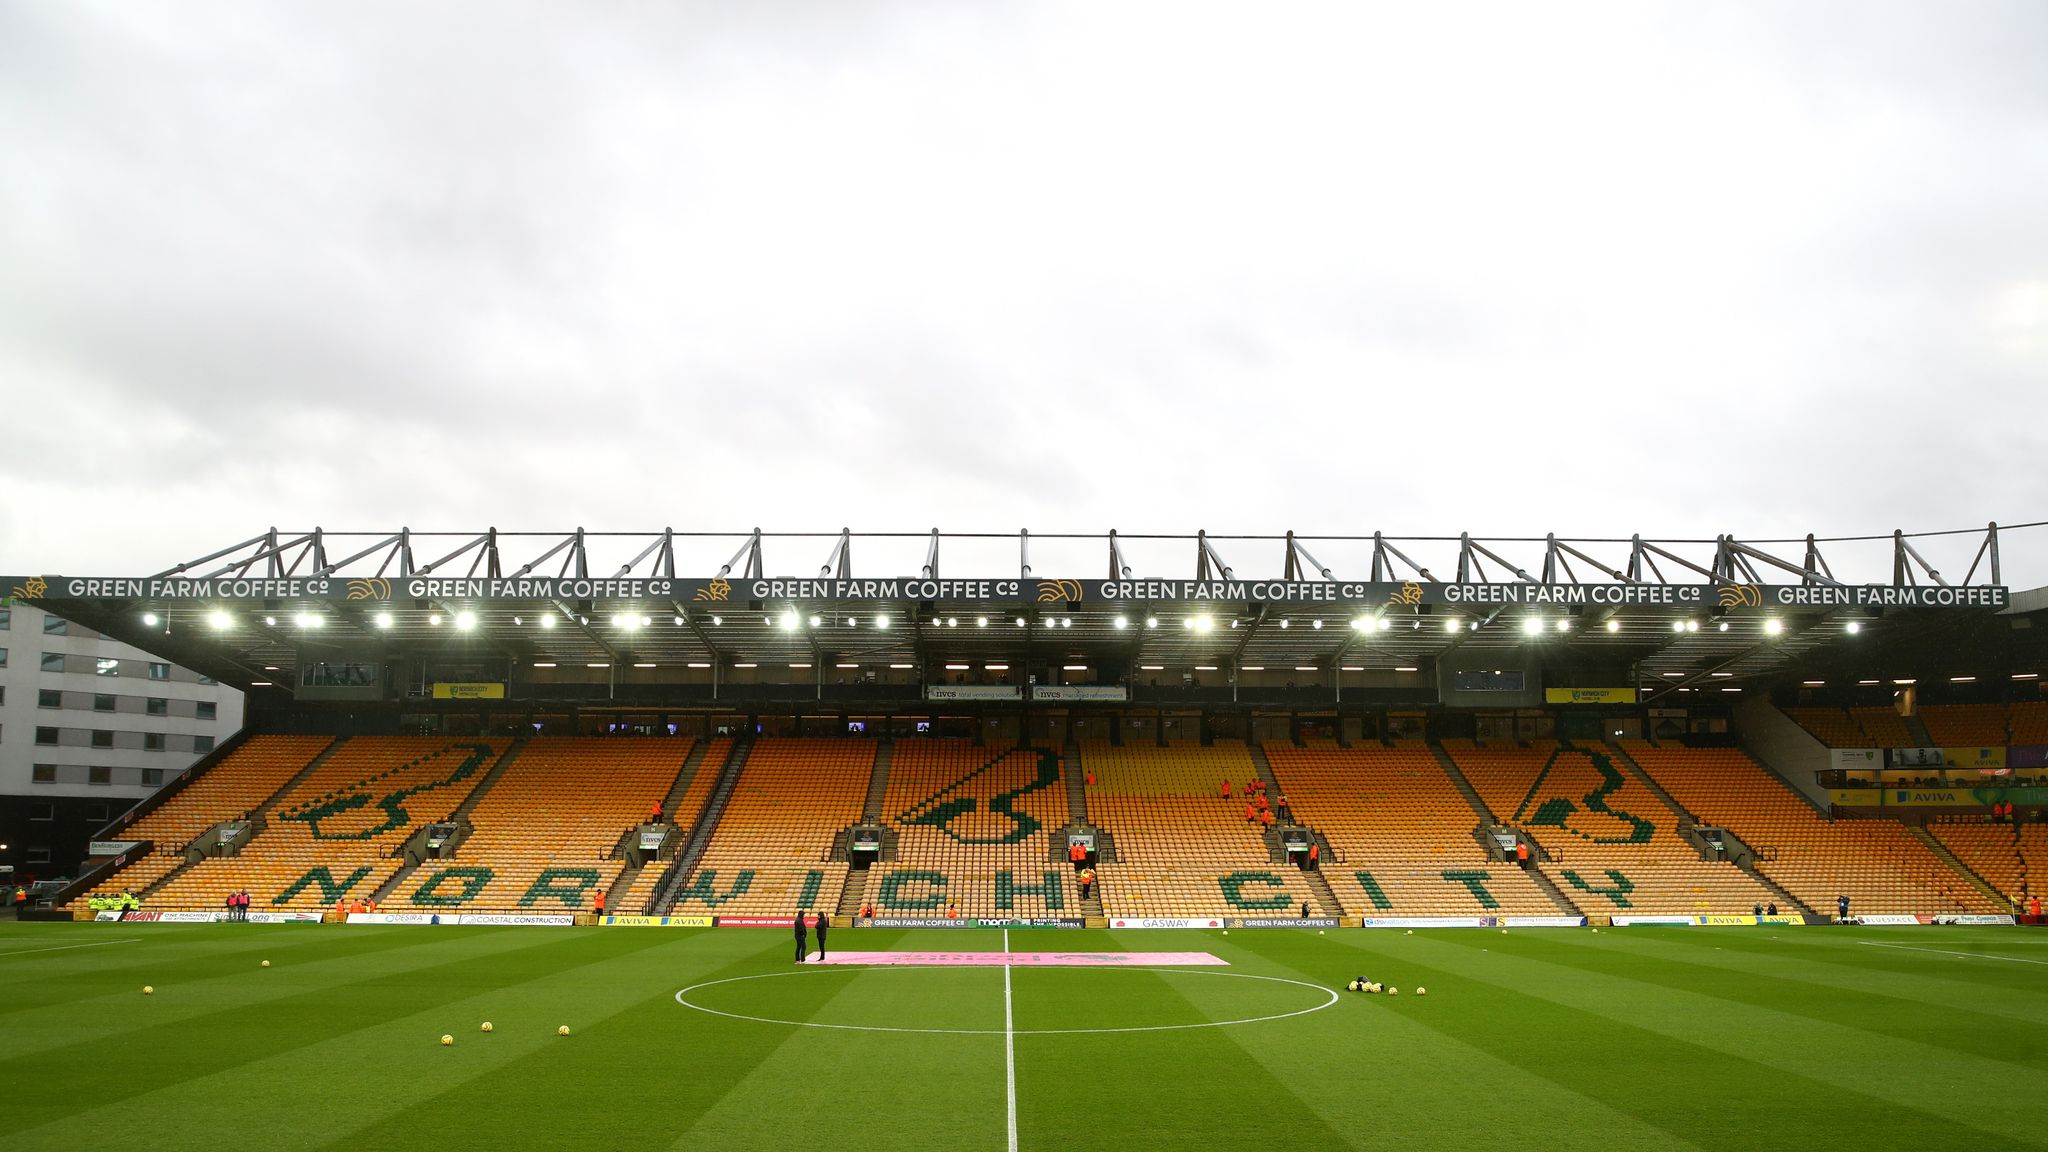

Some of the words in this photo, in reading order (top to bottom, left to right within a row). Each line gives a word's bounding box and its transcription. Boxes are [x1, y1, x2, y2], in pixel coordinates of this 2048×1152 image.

[68, 579, 143, 597] GREEN
[150, 580, 212, 597] FARM
[217, 580, 301, 598] COFFEE
[408, 579, 483, 598] GREEN
[490, 580, 552, 598] FARM
[558, 580, 642, 598] COFFEE
[752, 580, 828, 598] GREEN
[836, 581, 899, 598] FARM
[904, 581, 989, 599] COFFEE
[1100, 582, 1176, 600] GREEN
[1184, 582, 1247, 600] FARM
[1252, 583, 1336, 601] COFFEE
[1444, 584, 1518, 602] GREEN
[1525, 585, 1587, 603] FARM
[1591, 586, 1673, 604] COFFEE
[1778, 587, 1850, 604] GREEN
[1857, 587, 1917, 605] FARM
[1922, 588, 2003, 605] COFFEE
[936, 690, 956, 698] nvcs
[1040, 690, 1061, 698] nvcs
[1914, 793, 1956, 801] AVIVA
[123, 913, 163, 922] AVANT
[476, 916, 512, 924] COASTAL
[514, 917, 571, 925] CONSTRUCTION
[673, 918, 704, 926] AVIVA
